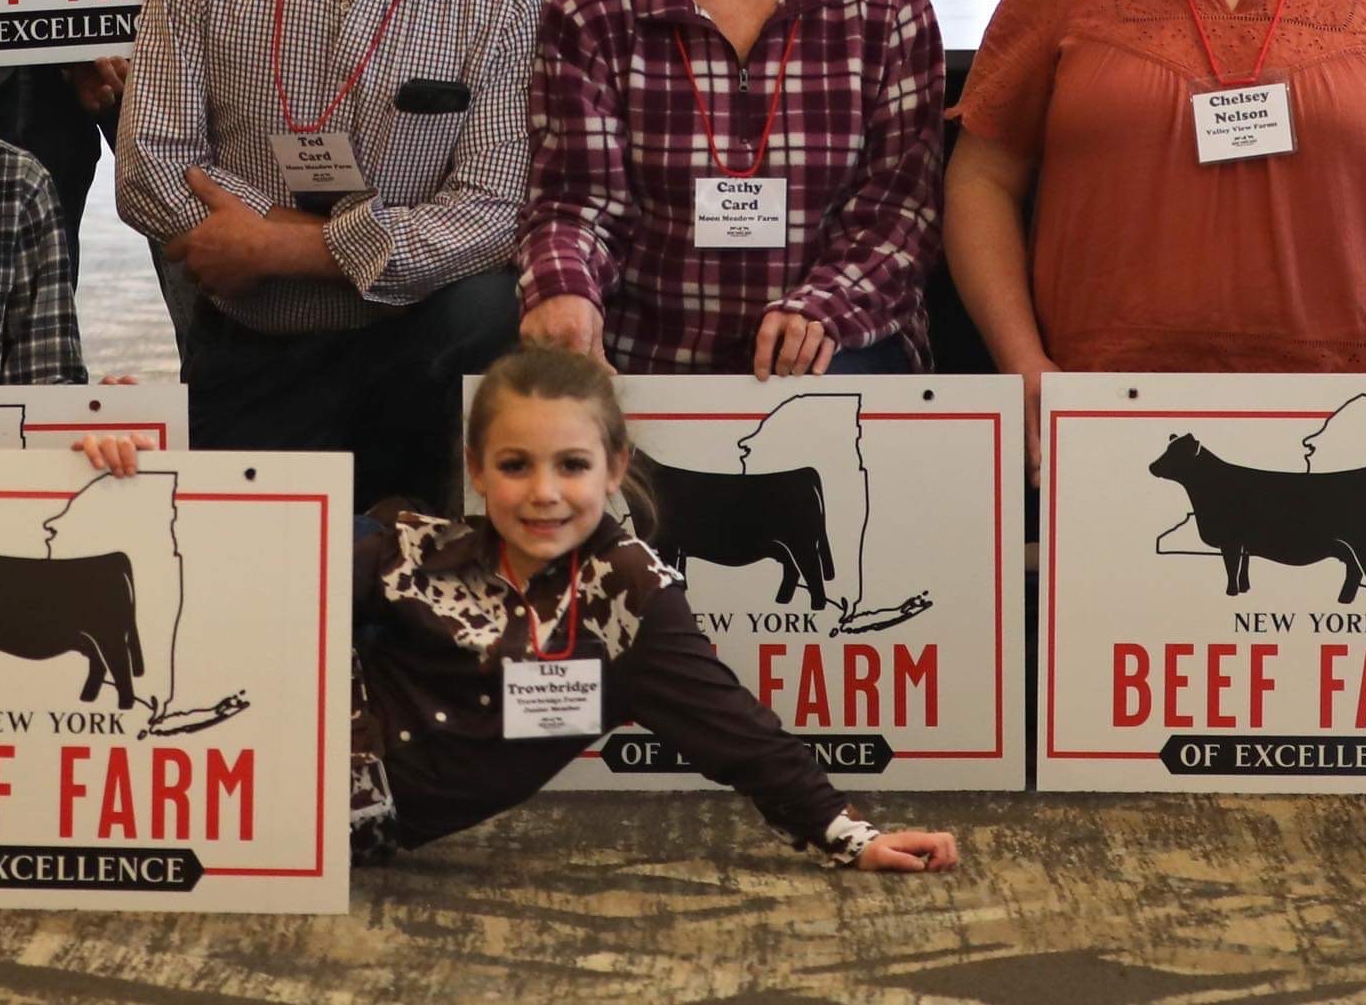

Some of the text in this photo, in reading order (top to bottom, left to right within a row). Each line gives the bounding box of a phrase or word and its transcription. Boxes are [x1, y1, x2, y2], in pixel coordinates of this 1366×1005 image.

[1209, 91, 1270, 108] Chelsey
[1214, 108, 1269, 125] Nelson
[1206, 121, 1278, 136] Valley View Farms
[297, 136, 324, 147] Ted
[298, 151, 332, 161] Card
[717, 181, 763, 195] Cathy
[721, 199, 759, 211] Card
[698, 214, 721, 222] Moon
[697, 613, 819, 634] EW YORK
[1234, 612, 1295, 634] NEW
[538, 664, 569, 677] Lily
[507, 681, 598, 695] Trowbridge
[758, 643, 939, 728] FARM
[1112, 642, 1279, 727] BEEF
[48, 710, 127, 736] YORK
[621, 742, 661, 765] OF
[1180, 744, 1221, 767] OF
[58, 746, 256, 842] FARM
